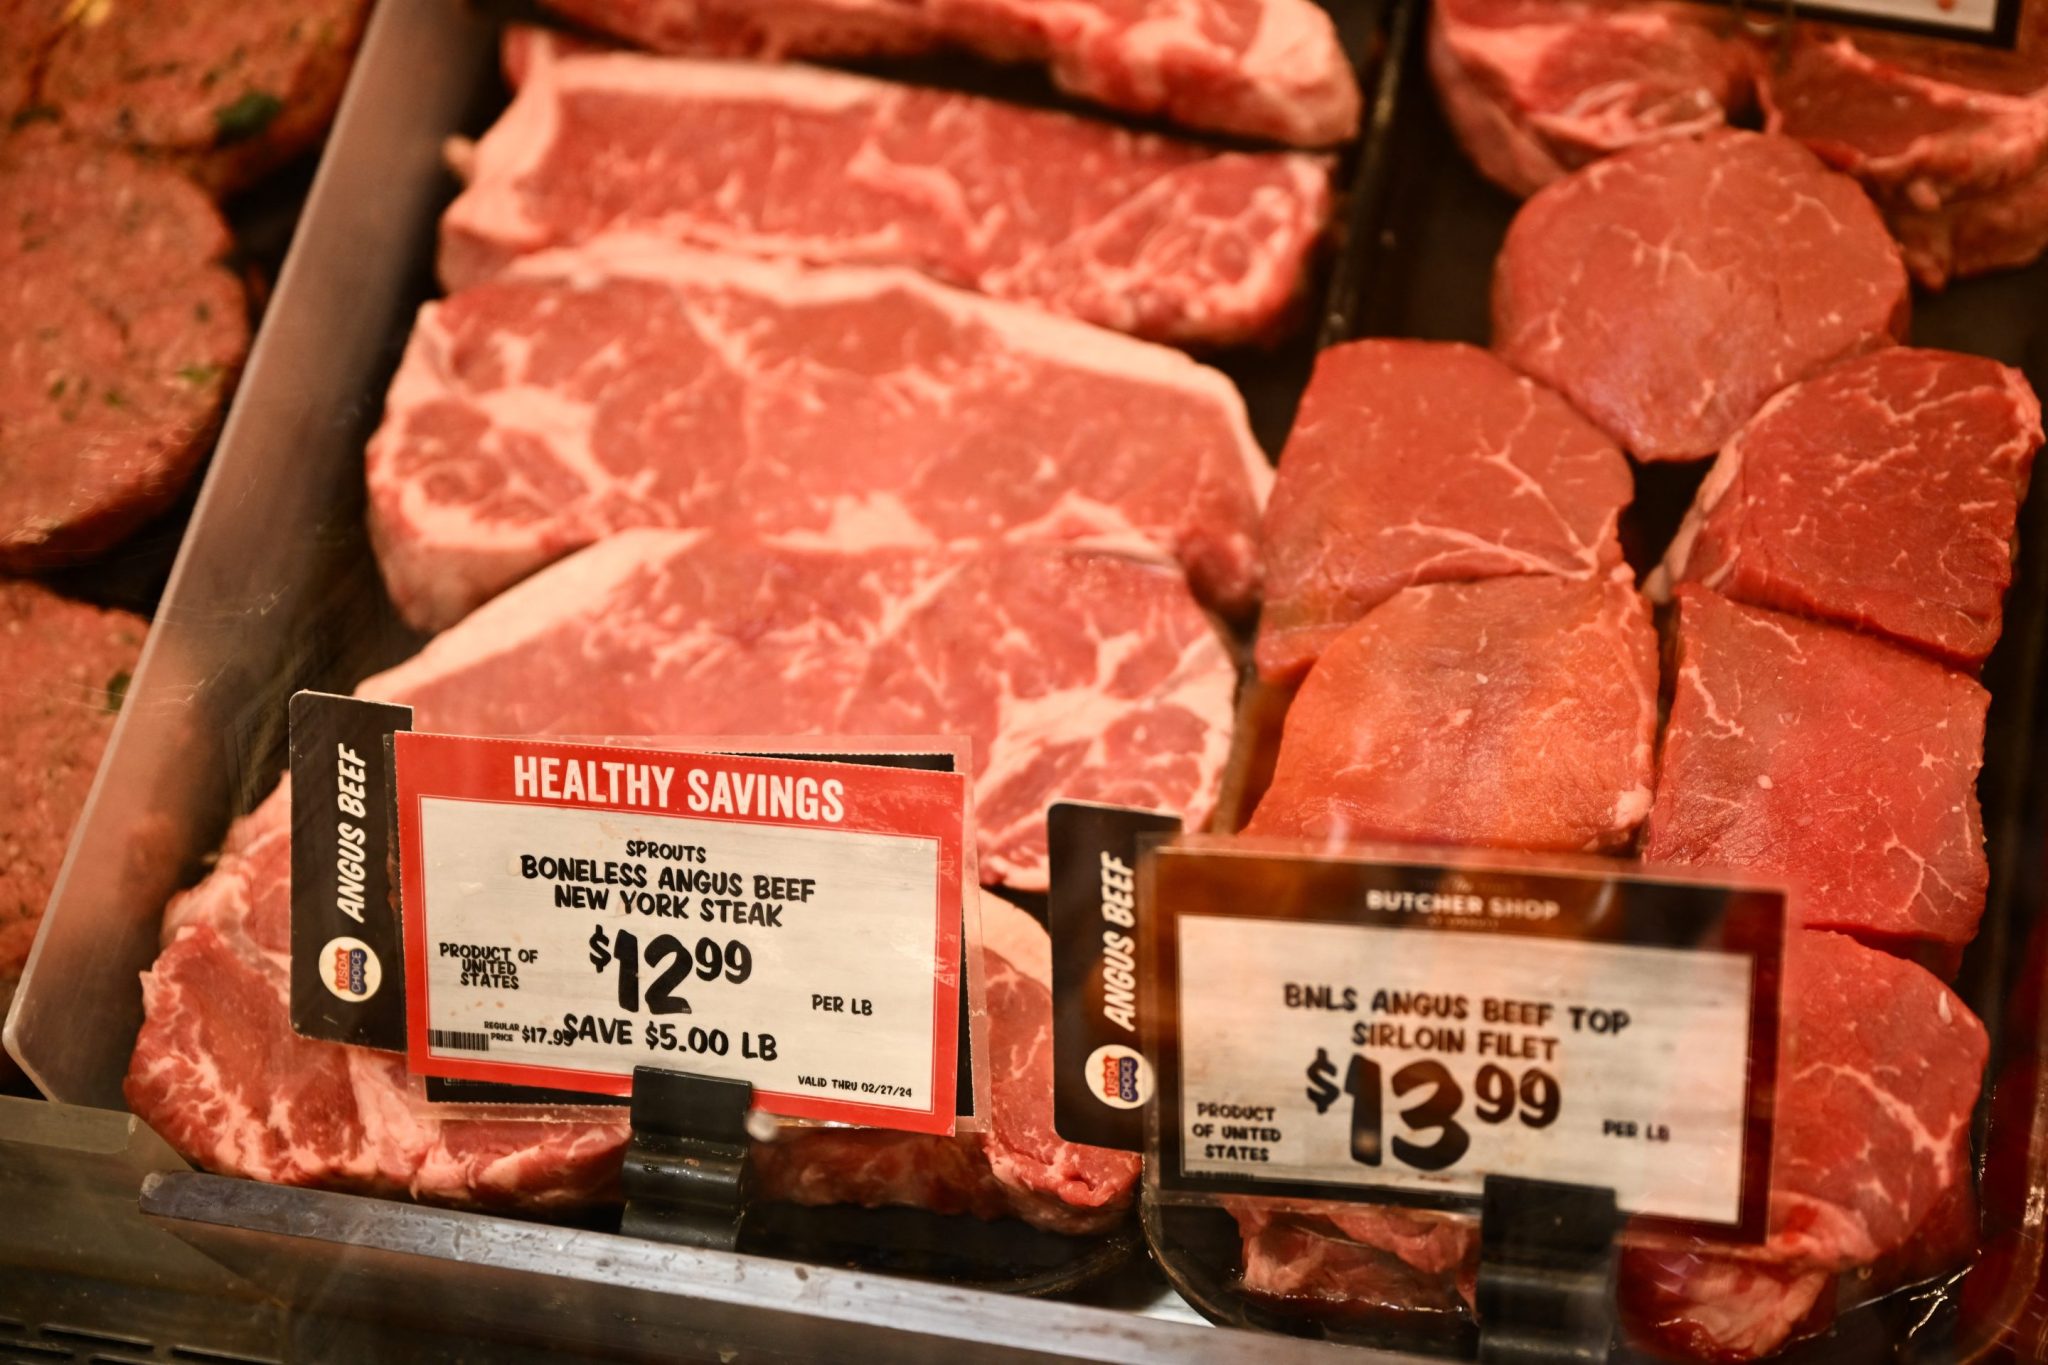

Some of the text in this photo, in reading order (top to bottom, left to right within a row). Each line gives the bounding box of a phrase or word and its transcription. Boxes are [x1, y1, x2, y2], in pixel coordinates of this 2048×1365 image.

[513, 755, 844, 822] HEALTHY SAVINGS
[336, 743, 366, 923] ANGUS BEEF
[626, 840, 706, 864] SPROUTS
[520, 854, 816, 903] BONELESS ANGUS BEEF
[554, 885, 783, 928] NEW YORK STEAK
[1366, 889, 1561, 920] BUTCHER SHOP
[439, 942, 538, 964] PRODUCT OF
[1100, 851, 1135, 1032] ANGUS BEEF
[337, 952, 348, 987] USDA
[351, 951, 362, 992] CHOICE
[462, 960, 517, 976] UNITED
[460, 973, 519, 990] STATES
[812, 994, 873, 1016] PER LB
[1284, 983, 1630, 1036] BNLS ANGUS BEEF TOP
[484, 1021, 519, 1031] REGULAR
[490, 1033, 514, 1042] PRICE
[564, 1013, 778, 1061] SAVE $5.00 LB
[1352, 1020, 1560, 1060] SIRLOIN FILET
[798, 1075, 912, 1098] VALID THRU 02/27/24
[1197, 1102, 1275, 1122] PRODUCT
[1192, 1121, 1282, 1143] OF UNITED
[1603, 1120, 1670, 1142] PER LB
[1205, 1143, 1269, 1162] STATES
